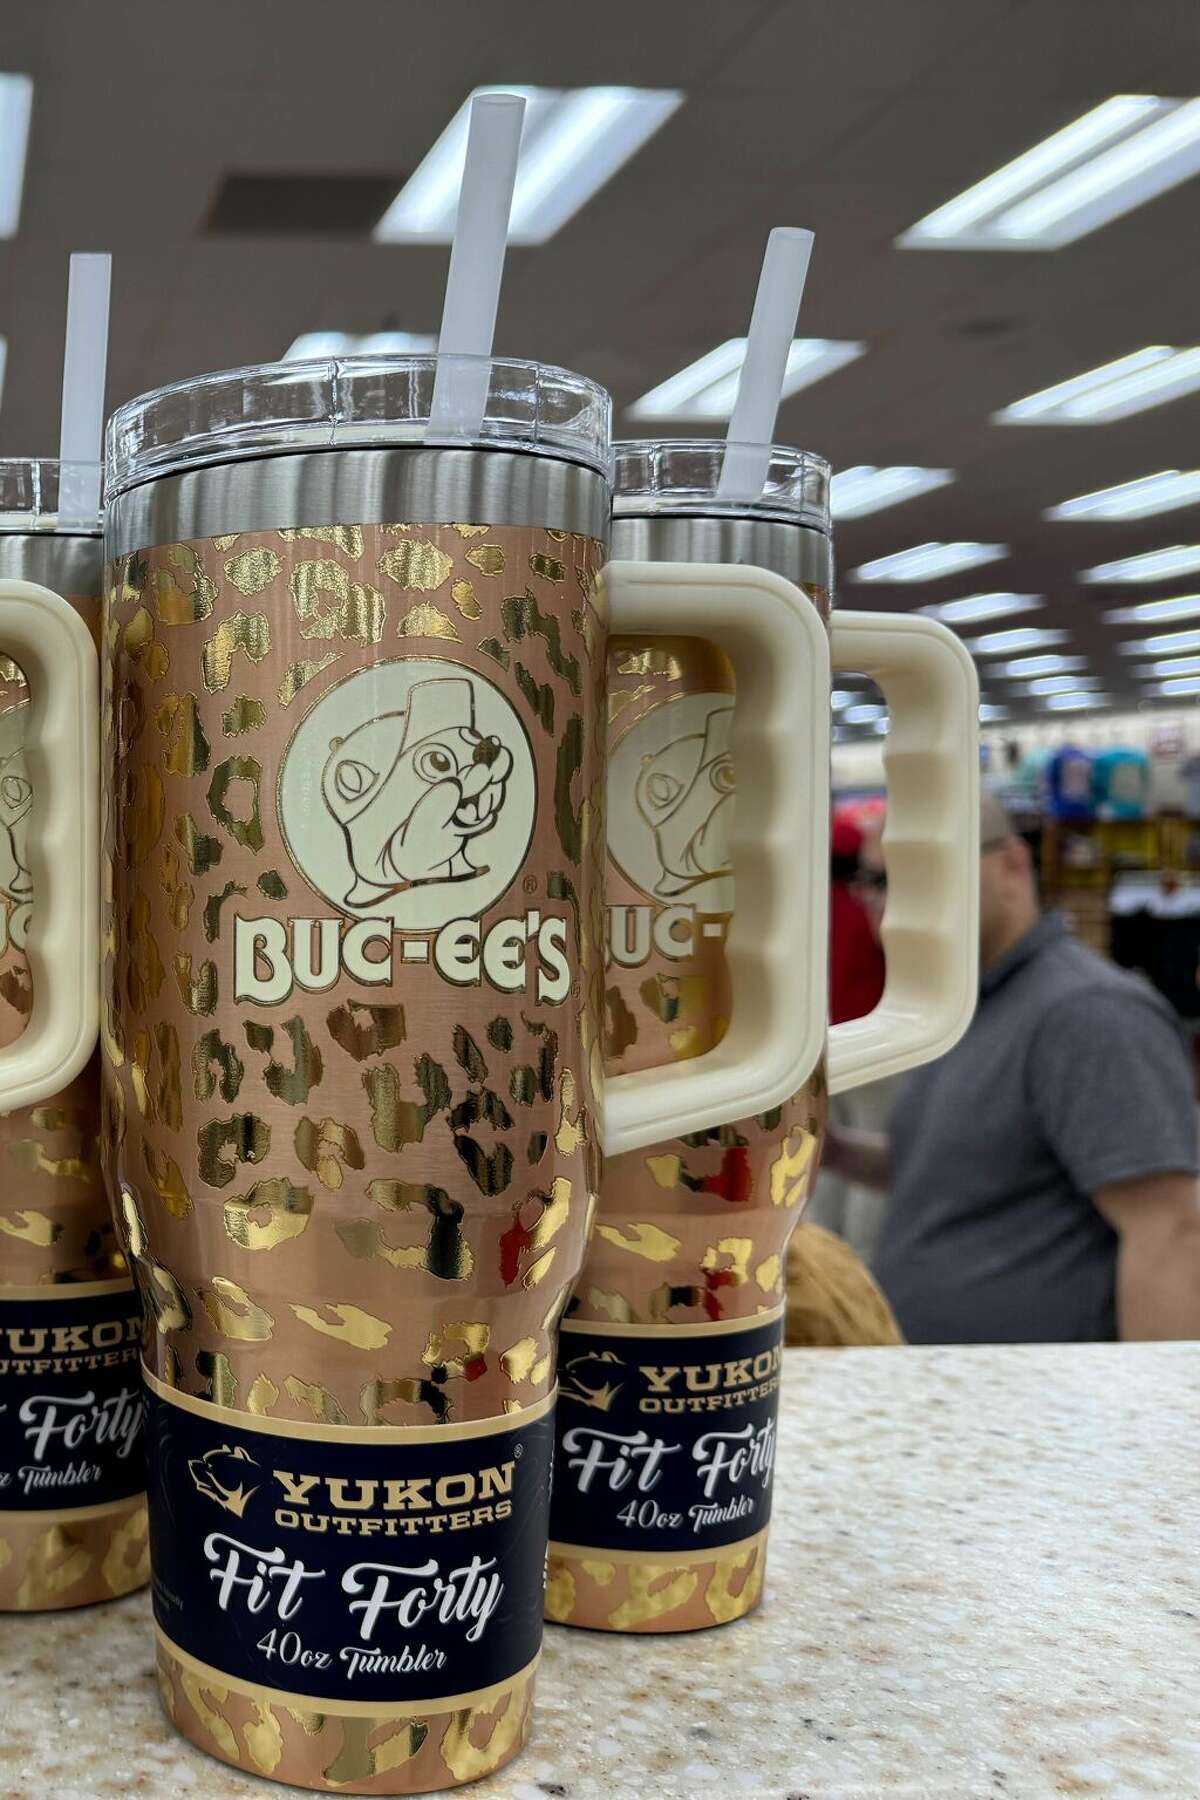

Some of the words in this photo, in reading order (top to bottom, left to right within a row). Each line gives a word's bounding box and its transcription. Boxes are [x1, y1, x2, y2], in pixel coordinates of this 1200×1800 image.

[234, 910, 571, 1006] BUC-EE'S
[19, 1388, 144, 1460] Forty
[17, 1461, 102, 1495] Tumbler
[273, 1461, 516, 1508] YUKON
[563, 1427, 681, 1493] Fit
[275, 1501, 513, 1536] OUTFITTERS
[617, 1500, 684, 1529] 40oz
[688, 1495, 754, 1533] Tumbler
[204, 1532, 325, 1622] Fit
[342, 1556, 504, 1642] Forty
[256, 1629, 331, 1671] 40oz
[340, 1645, 448, 1680] Tumbler
